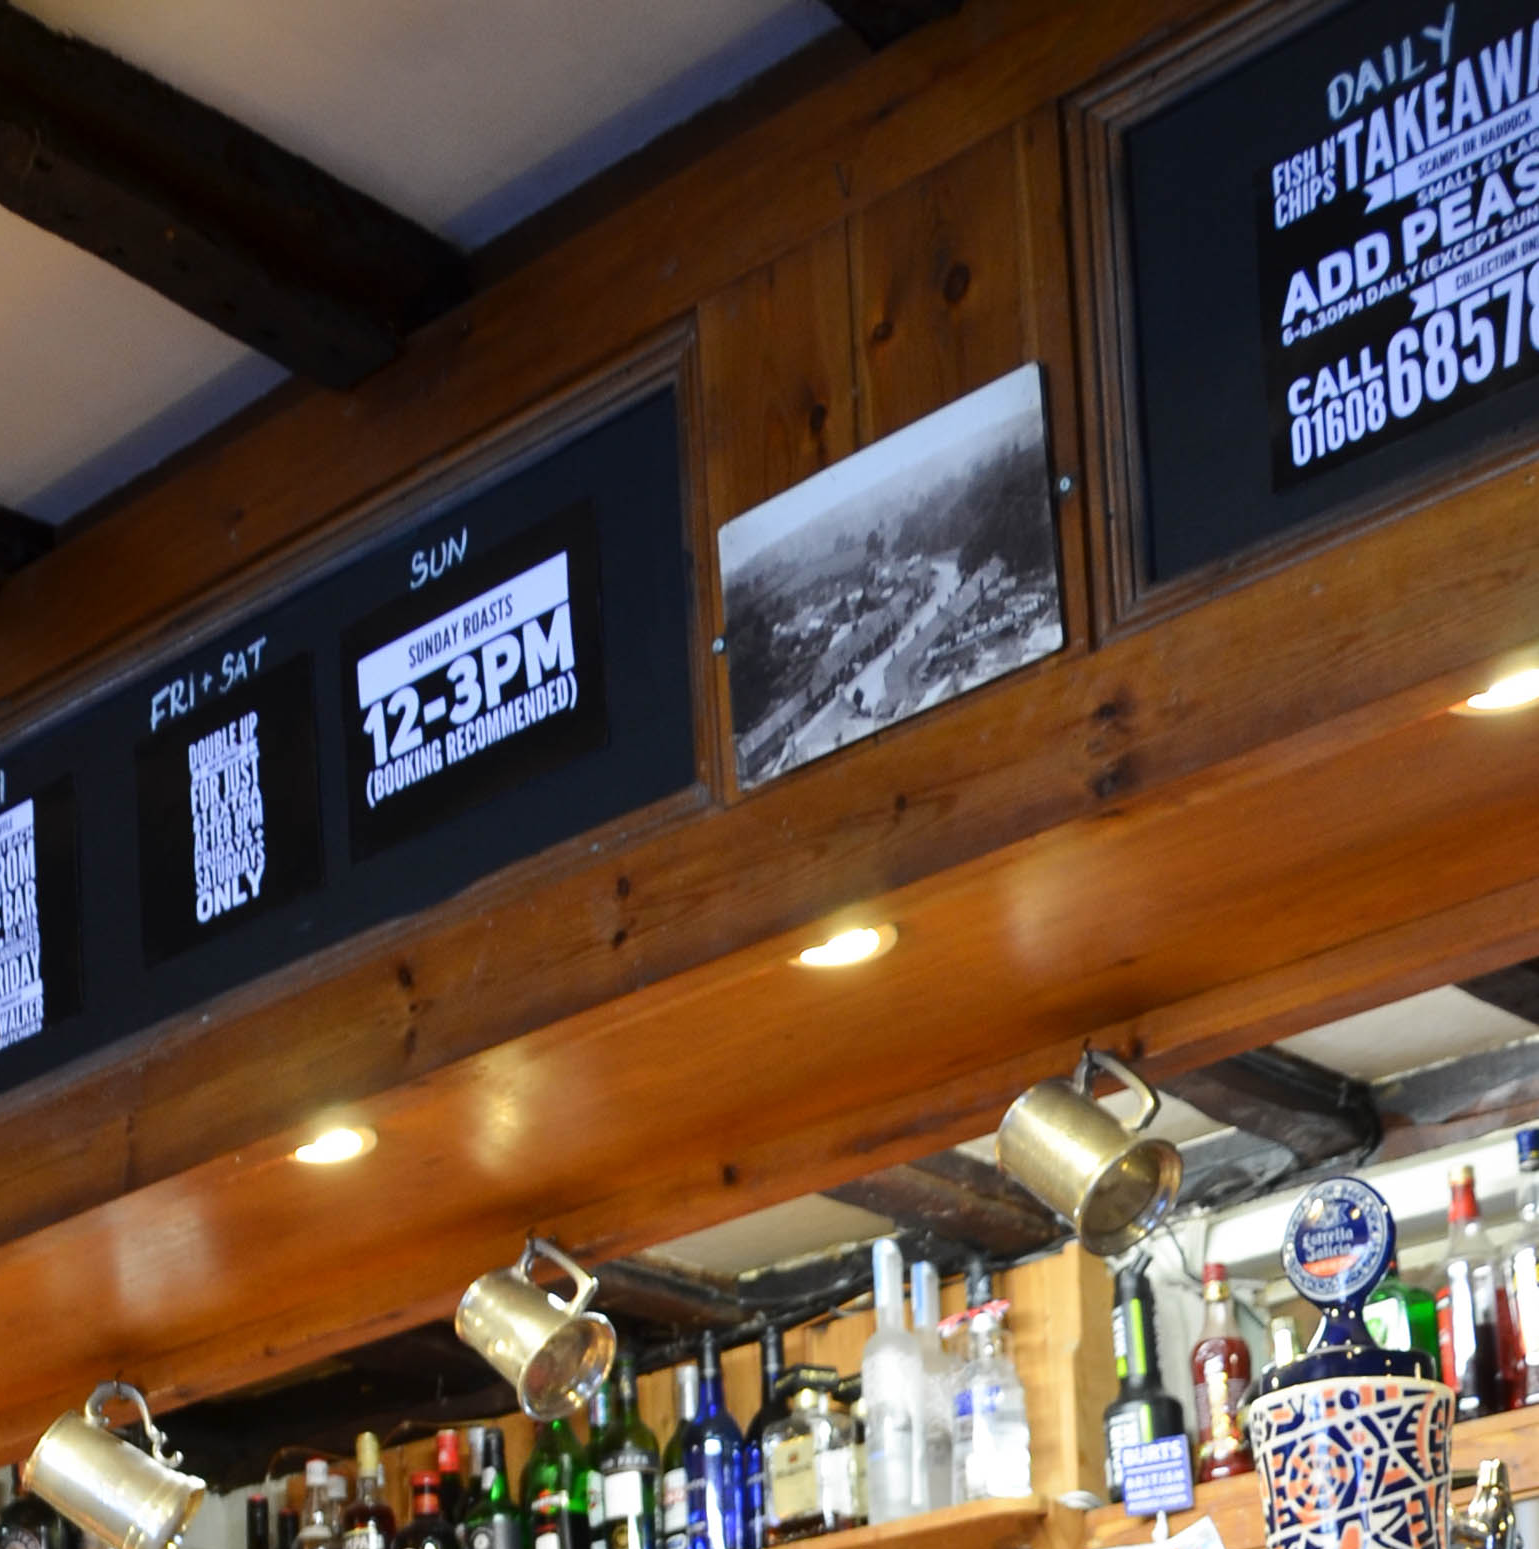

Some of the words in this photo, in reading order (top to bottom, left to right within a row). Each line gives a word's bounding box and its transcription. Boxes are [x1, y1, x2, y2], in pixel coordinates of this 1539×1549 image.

[1326, 2, 1456, 121] DAILY
[1480, 104, 1533, 153] HADDOCK
[1272, 146, 1317, 200] FISH
[1321, 136, 1337, 172] N
[1274, 167, 1337, 231] CHIPS
[1416, 166, 1478, 208] SMALL
[1281, 230, 1391, 328] ADD
[1401, 150, 1539, 266] PEAS
[1454, 243, 1518, 291] COLLECTION
[1366, 266, 1419, 308] DAILY
[1287, 345, 1384, 416] CALL
[1290, 377, 1388, 468] 01608
[410, 527, 468, 590] SUN
[409, 620, 460, 668] SUNDAY
[463, 593, 513, 640] ROASTS
[150, 671, 195, 732] FRI
[220, 635, 267, 694] SAT
[363, 601, 575, 768] 12-3PM
[188, 720, 237, 776] DOUBLE
[239, 711, 258, 746] UP
[366, 737, 443, 809] (BOOKING
[445, 670, 578, 766] RECOMMENDED)
[191, 771, 220, 817] FOR
[223, 745, 259, 803] JUST
[2, 880, 37, 930] BAR
[196, 866, 264, 923] ONLY
[1302, 1226, 1354, 1250] Estrella
[1121, 1439, 1183, 1467] BURTS
